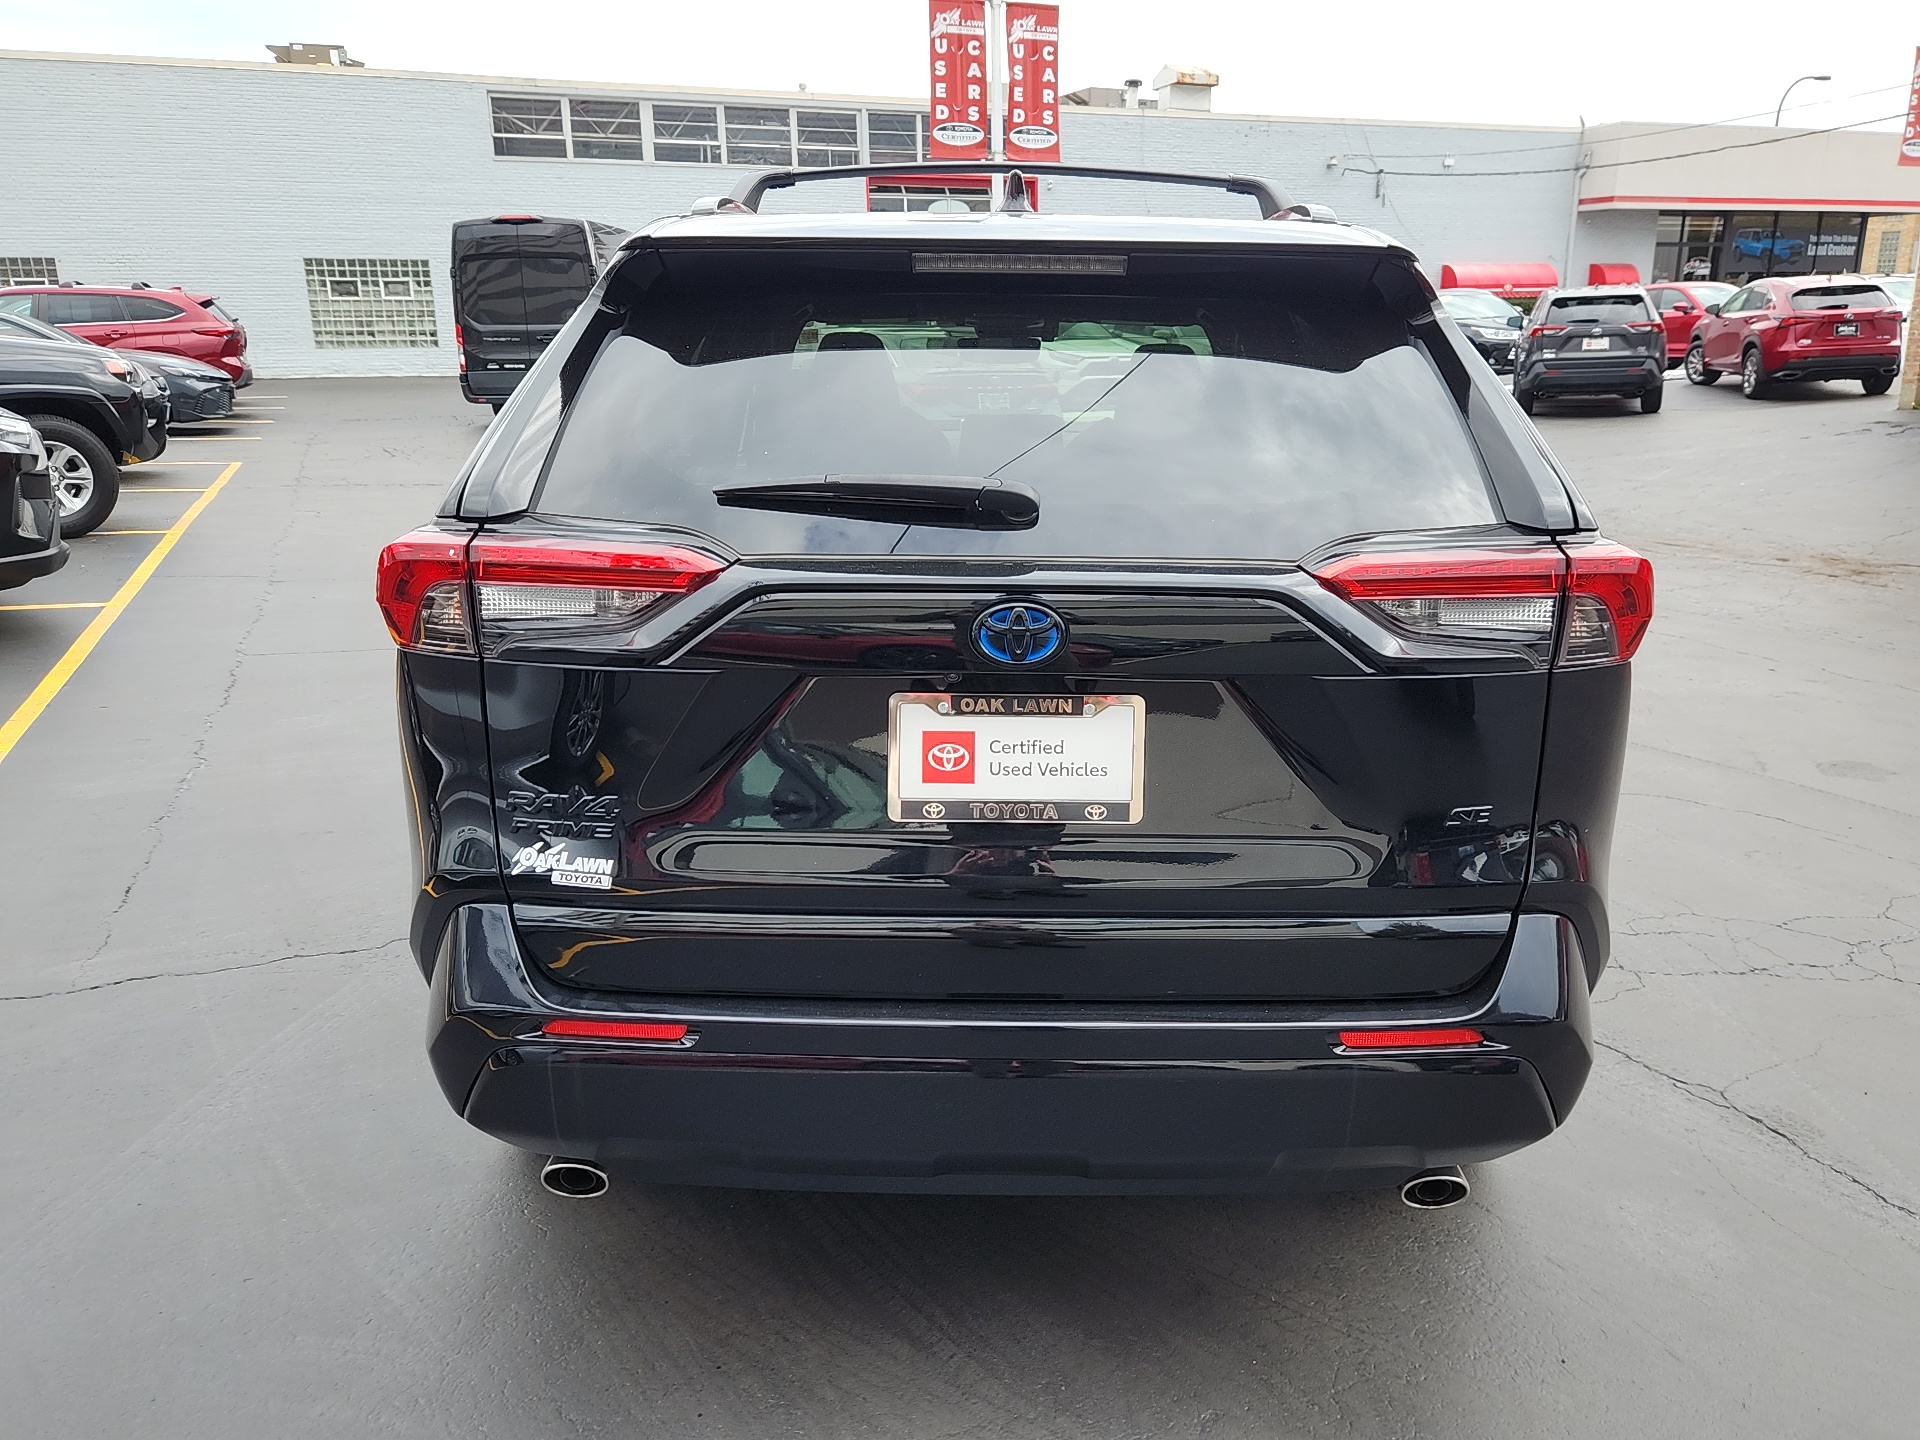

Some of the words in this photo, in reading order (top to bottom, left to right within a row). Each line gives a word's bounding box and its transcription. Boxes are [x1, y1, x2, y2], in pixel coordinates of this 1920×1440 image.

[961, 19, 985, 28] LAWN
[934, 37, 949, 120] USED
[967, 39, 982, 122] CARS
[1012, 43, 1026, 123] USED
[1042, 45, 1056, 125] CARS
[960, 697, 1006, 714] OAK
[1012, 697, 1073, 714] LAWN
[989, 739, 1065, 755] Certified
[989, 761, 1033, 777] Used
[1036, 761, 1108, 777] Vehicles
[506, 790, 621, 819] RAV4
[969, 802, 1059, 820] TOYOTA
[511, 816, 616, 838] PRIME
[558, 872, 603, 885] TOYOTA
